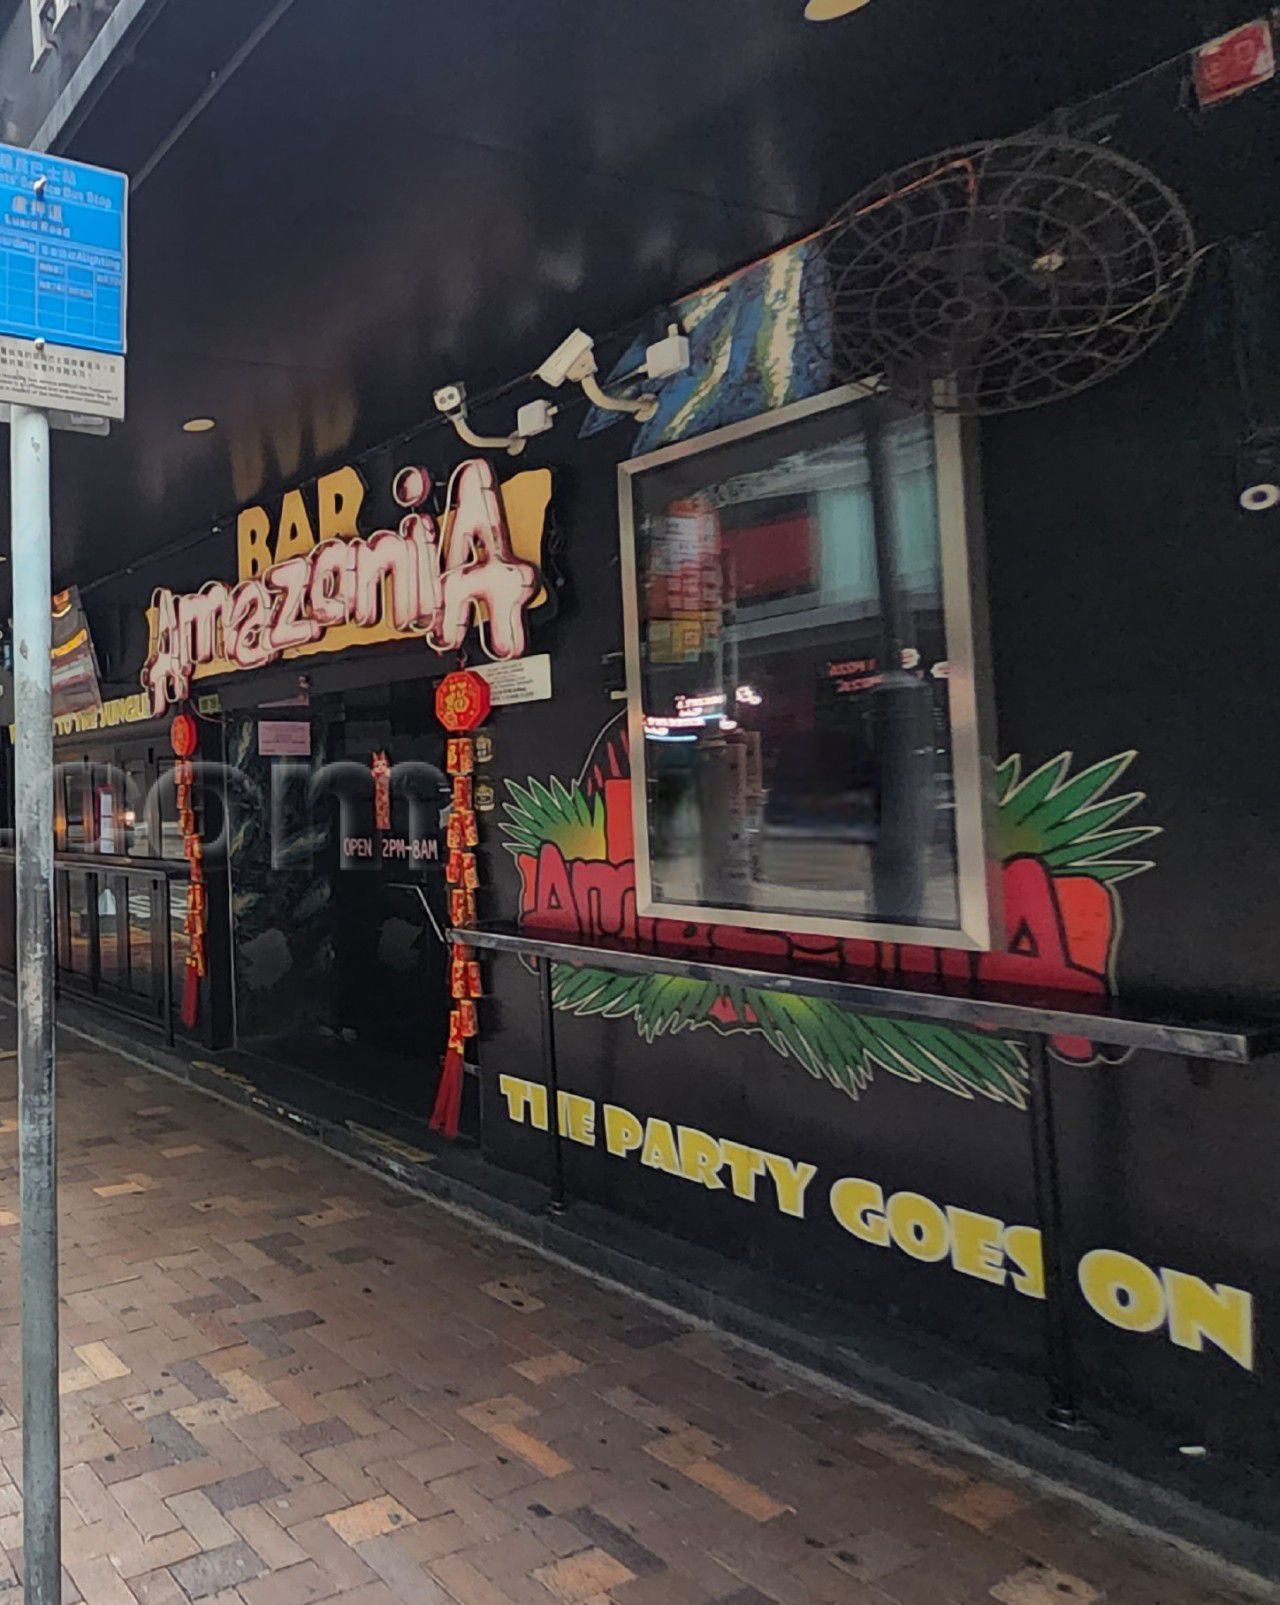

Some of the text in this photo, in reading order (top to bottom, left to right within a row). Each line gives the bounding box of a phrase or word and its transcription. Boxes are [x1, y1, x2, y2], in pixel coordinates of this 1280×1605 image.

[237, 464, 365, 583] BAR
[343, 837, 372, 857] OPEN
[603, 1103, 817, 1219] PARTY
[829, 1177, 1047, 1300] GOES
[1076, 1248, 1255, 1373] ON
